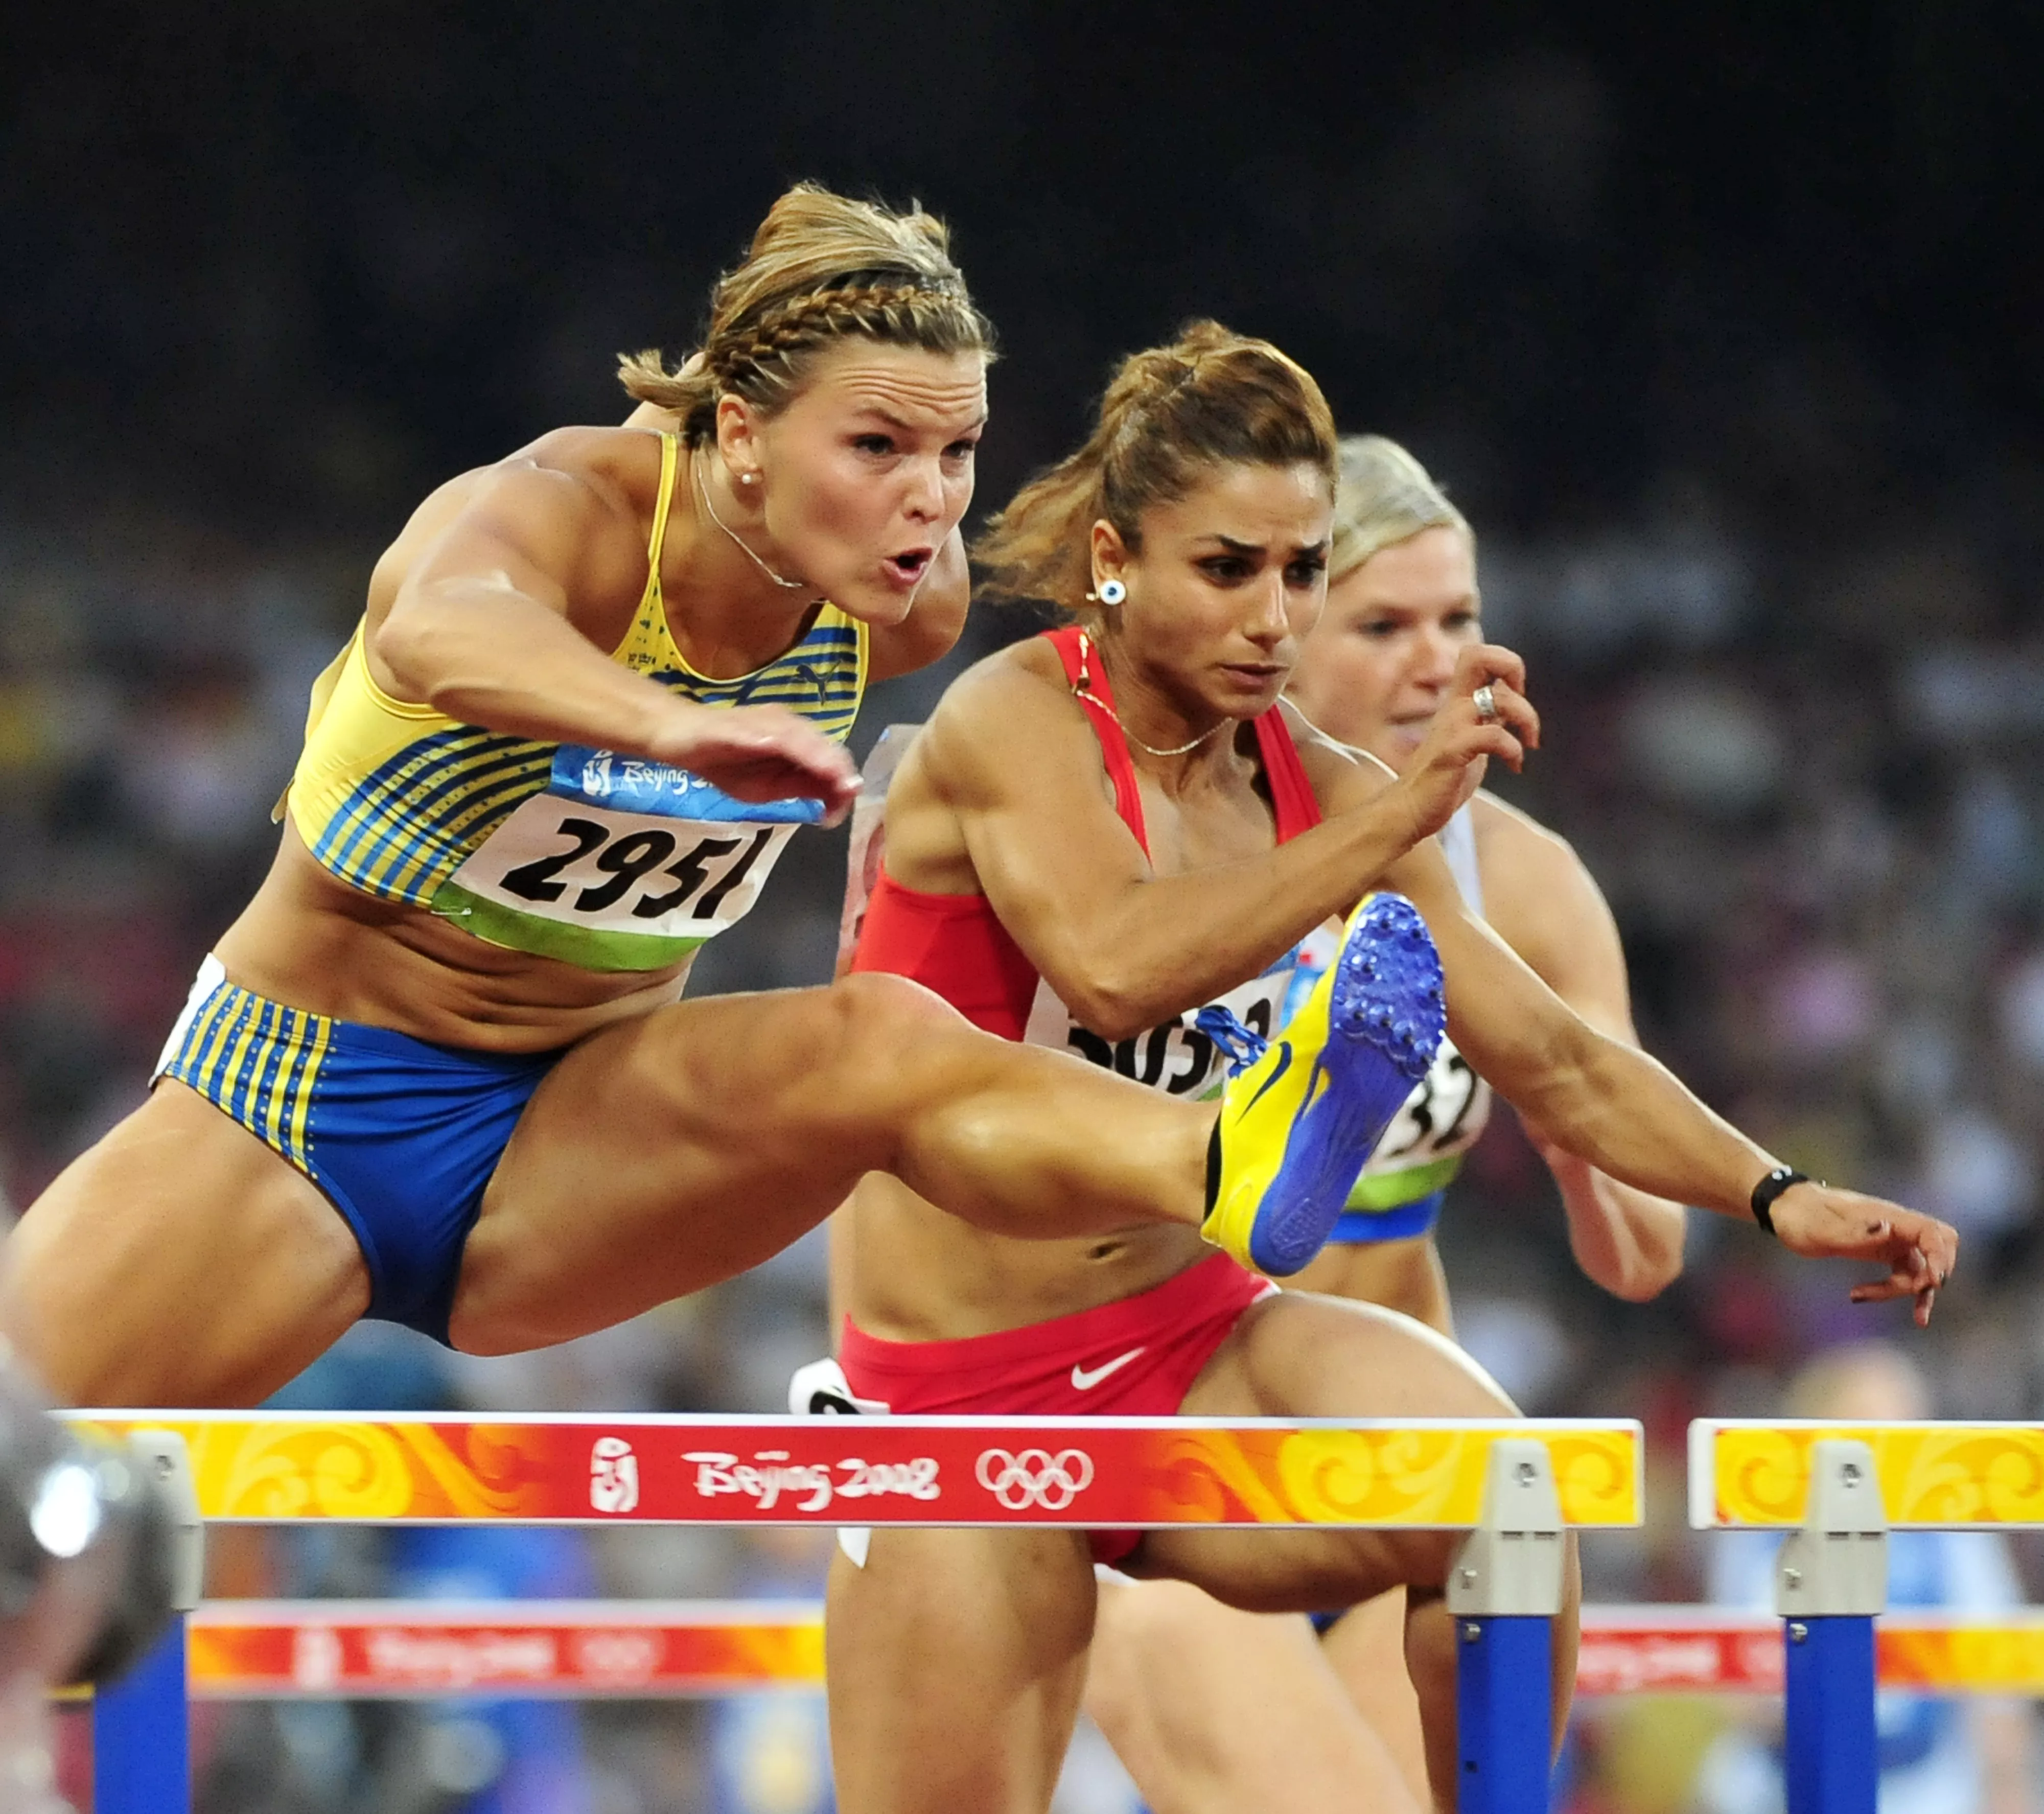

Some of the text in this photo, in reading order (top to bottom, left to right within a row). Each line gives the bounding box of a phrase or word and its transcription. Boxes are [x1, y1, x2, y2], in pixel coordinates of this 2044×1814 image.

[621, 761, 688, 796] Beijing
[499, 818, 774, 919] 2951
[680, 1450, 941, 1512] Beijing 2008
